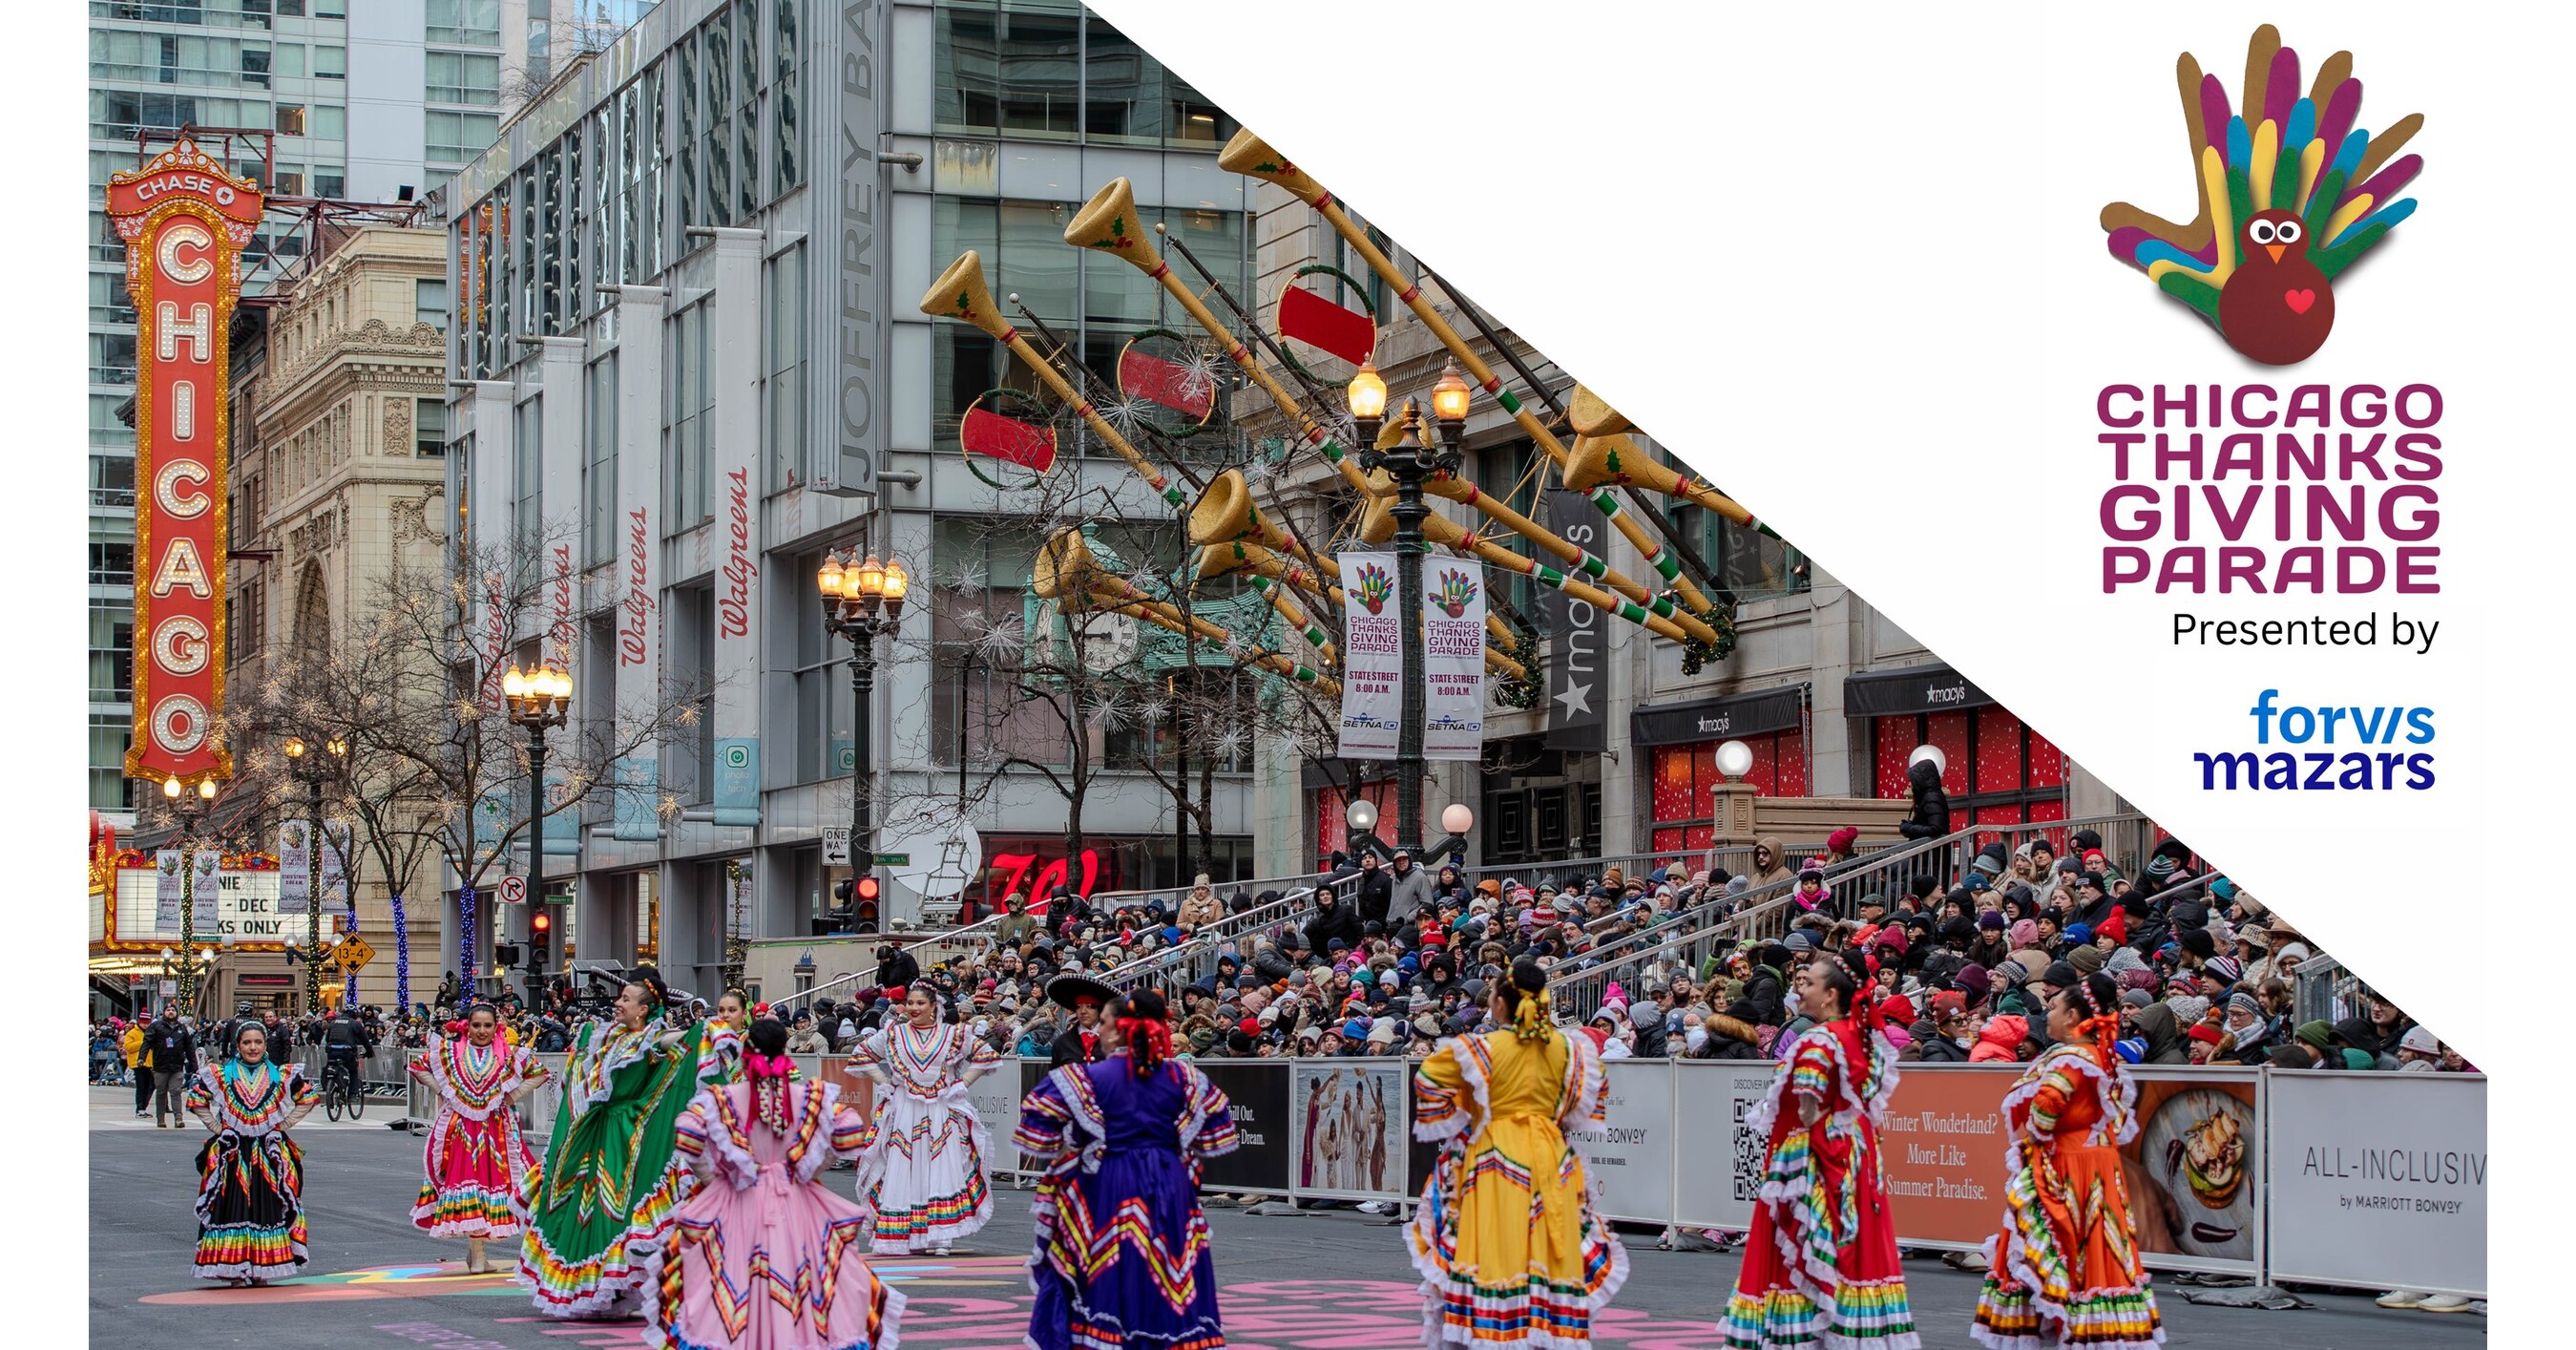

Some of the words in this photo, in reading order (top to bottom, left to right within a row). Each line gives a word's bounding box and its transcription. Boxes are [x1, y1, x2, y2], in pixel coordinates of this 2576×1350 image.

[136, 175, 214, 200] CHASE
[842, 123, 871, 484] JOFFREY
[150, 223, 214, 754] CHICAGO
[721, 466, 758, 641] Walgreens
[620, 505, 656, 667] Walgreens
[1350, 616, 1398, 626] CHICAGO
[1428, 621, 1479, 629] CHICAGO
[1351, 623, 1398, 635] THANKS
[1428, 628, 1480, 638] THANKS
[1351, 632, 1398, 644] GIVING
[1428, 637, 1479, 647] GIVING
[1351, 643, 1398, 653] PARADE
[1429, 646, 1479, 656] PARADE
[1349, 670, 1372, 681] STATE
[1372, 671, 1398, 682] STREET
[1429, 674, 1452, 684] STATE
[1453, 674, 1479, 685] STREET
[1355, 684, 1373, 693] 8:00
[1374, 685, 1391, 694] A.M.
[1437, 686, 1454, 696] 8:00
[1456, 686, 1471, 696] A.M.
[1934, 679, 1965, 705] macy's
[1343, 720, 1382, 729] SETNA
[1427, 723, 1466, 731] SETNA
[1703, 711, 1729, 734] macy's
[826, 831, 847, 840] ONE
[239, 898, 268, 913] DEC
[243, 919, 283, 935] ONLY
[1240, 1105, 1255, 1121] Out.
[1881, 1110, 1919, 1132] Winter
[1921, 1111, 1999, 1134] Wonderland?
[1241, 1129, 1266, 1145] Dream.
[1906, 1143, 1937, 1165] More
[1938, 1144, 1967, 1167] Like
[2303, 1146, 2487, 1186] ALL-INCLUSIV
[1886, 1174, 1934, 1197] Summer
[1936, 1176, 1988, 1200] Paradise.
[2339, 1194, 2353, 1211] by
[2356, 1194, 2412, 1212] MARRIOTT
